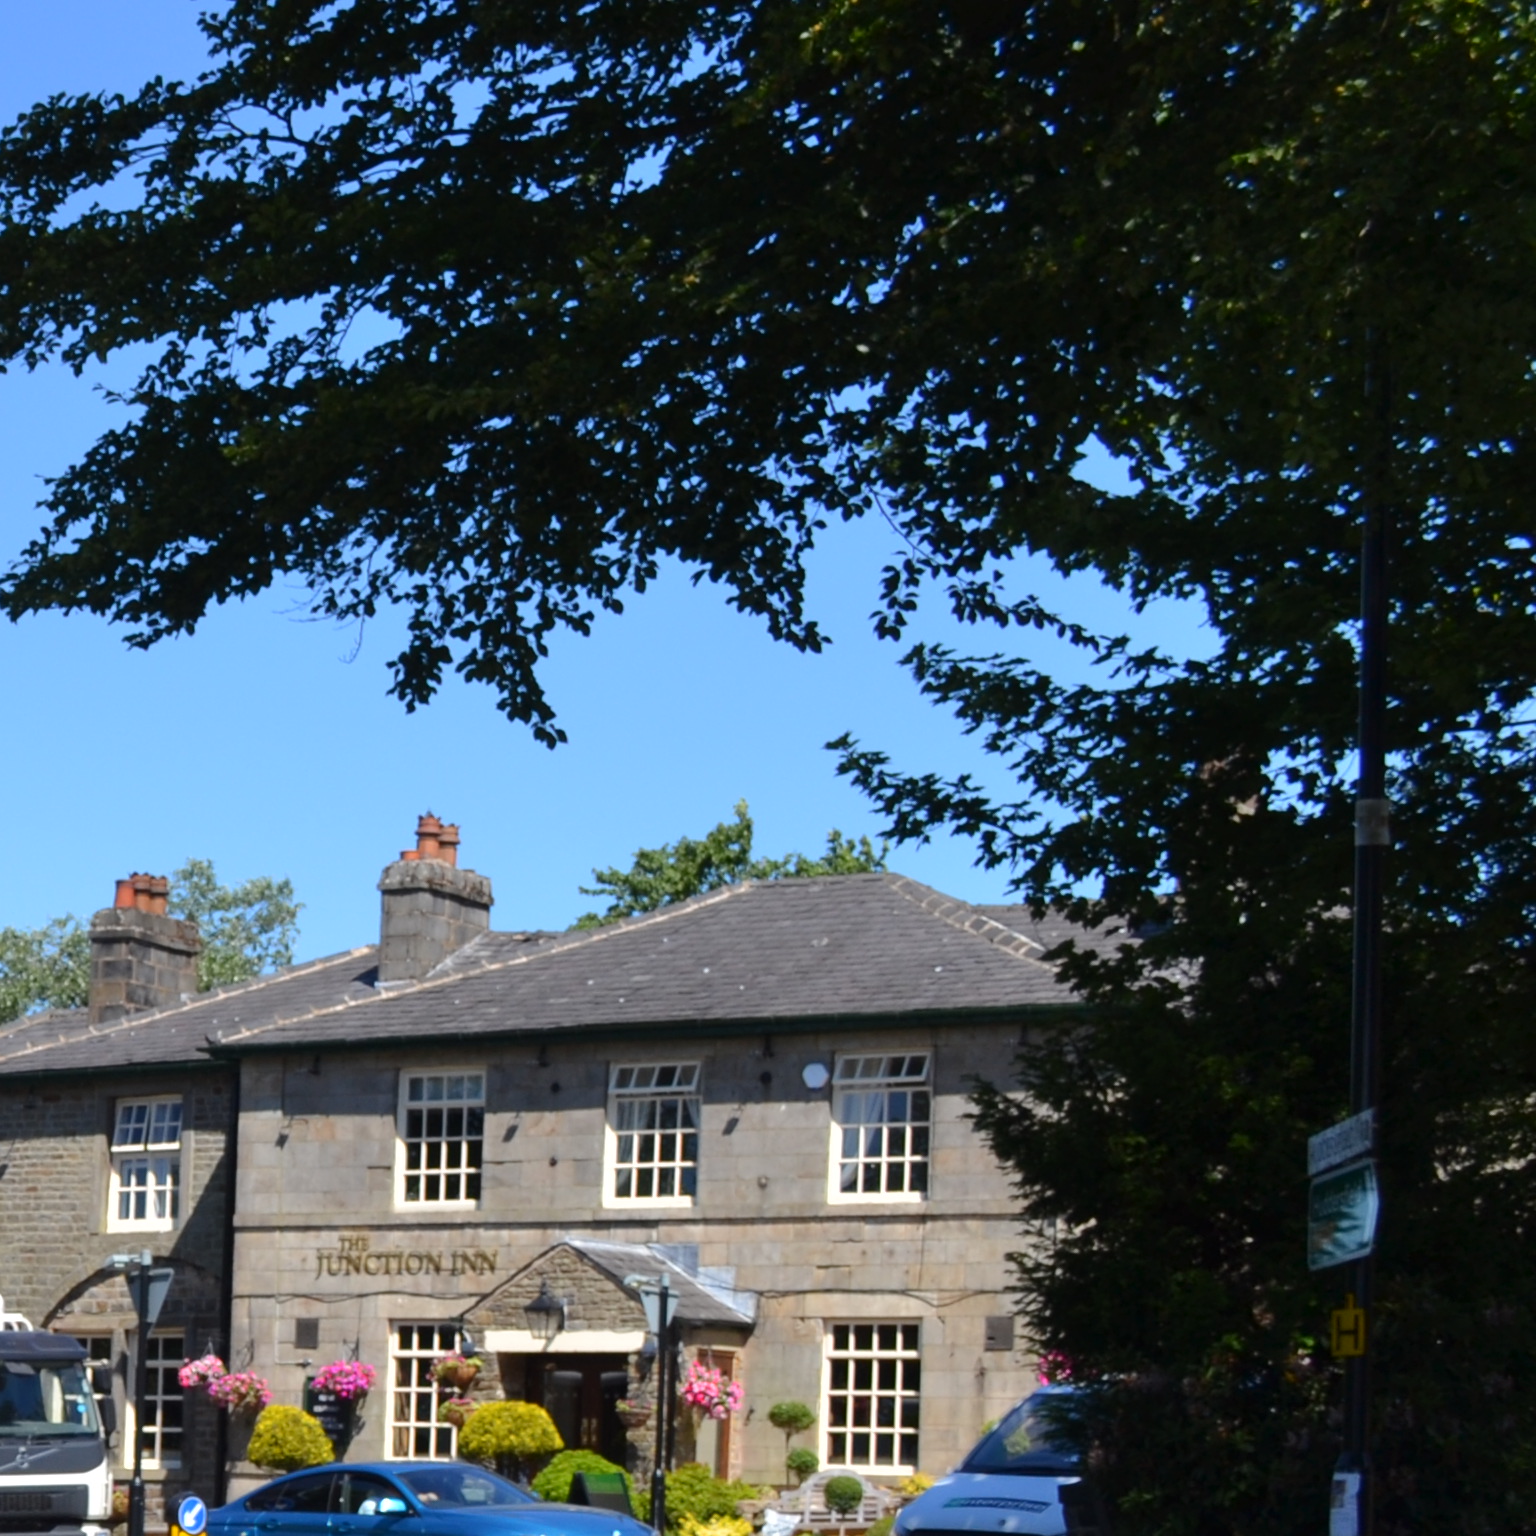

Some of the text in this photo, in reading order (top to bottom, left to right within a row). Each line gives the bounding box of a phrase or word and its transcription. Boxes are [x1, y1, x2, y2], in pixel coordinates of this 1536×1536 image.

[339, 1235, 370, 1251] THE
[316, 1250, 499, 1279] JUNCTION INN
